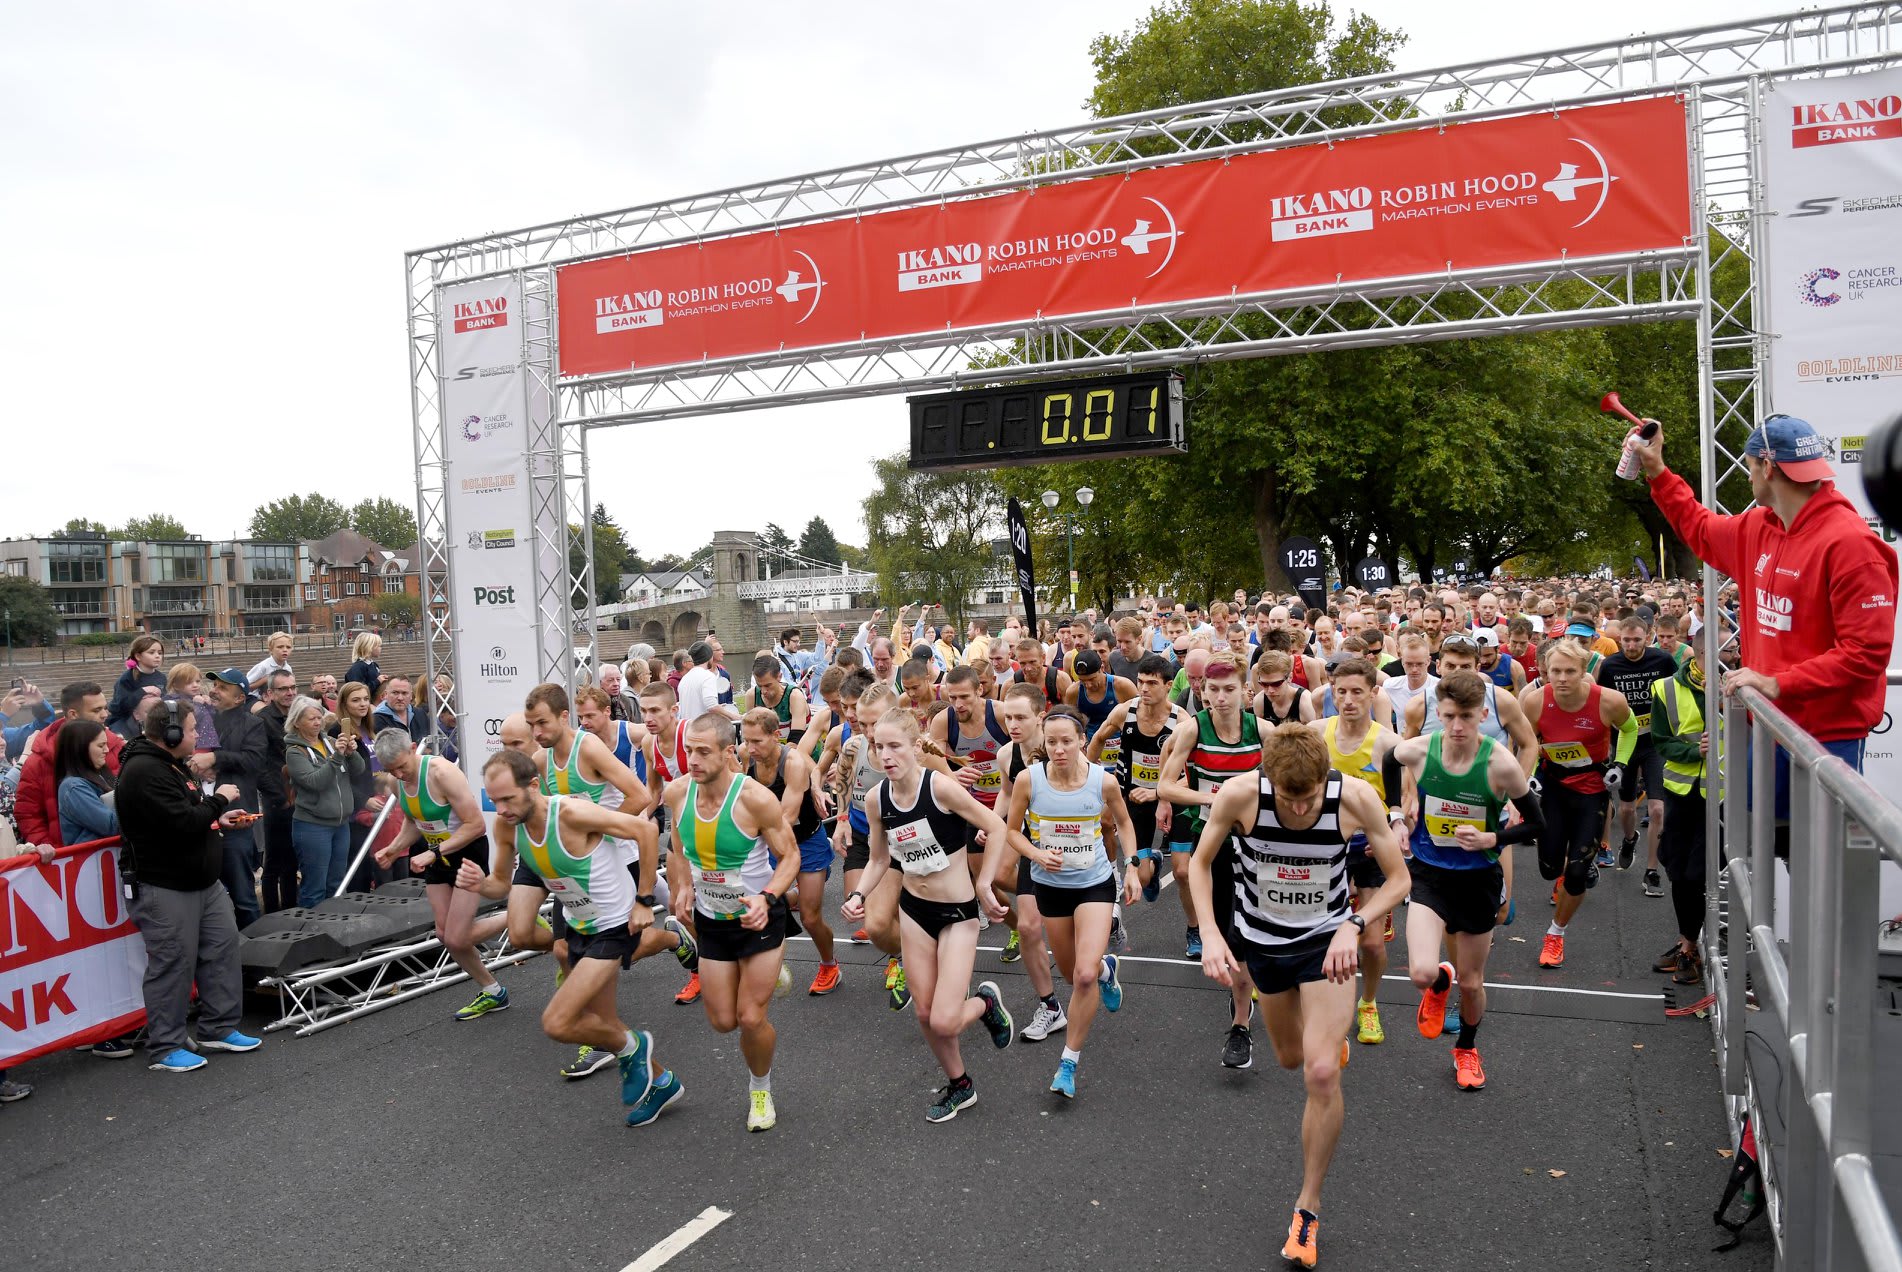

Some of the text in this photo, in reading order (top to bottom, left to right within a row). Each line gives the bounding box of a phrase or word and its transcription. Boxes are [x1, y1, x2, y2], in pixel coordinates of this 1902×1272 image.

[1791, 95, 1902, 126] IKANO
[1817, 125, 1877, 142] BANK
[1269, 172, 1537, 220] IKANO ROBIN HOOD
[1381, 194, 1538, 222] MARATHON EVENTS
[1294, 217, 1350, 234] BANK
[897, 228, 1117, 271] IKANO ROBIN HOOD
[988, 248, 1117, 274] MARATHON EVENTS
[917, 270, 963, 285] BANK
[1848, 266, 1895, 279] CANCER
[595, 278, 773, 316] IKANO ROBIN HOOD
[1848, 290, 1864, 301] UK
[453, 296, 507, 319] IKANO
[668, 296, 773, 319] MARATHON EVENTS
[466, 316, 496, 329] BANK
[611, 314, 648, 328] BANK
[1826, 374, 1880, 383] EVENTS
[483, 414, 507, 423] CANCER
[484, 422, 513, 430] RESEARCH
[1286, 549, 1317, 568] 1:25
[1362, 566, 1386, 581] 1:30
[473, 585, 516, 605] Post
[480, 663, 518, 676] Hilton
[1614, 680, 1645, 691] HELP
[1555, 749, 1582, 760] 4921
[1441, 801, 1469, 811] IKANO
[903, 843, 941, 863] SOPHIE
[1277, 866, 1310, 875] IKANO
[1267, 889, 1325, 905] CHRIS
